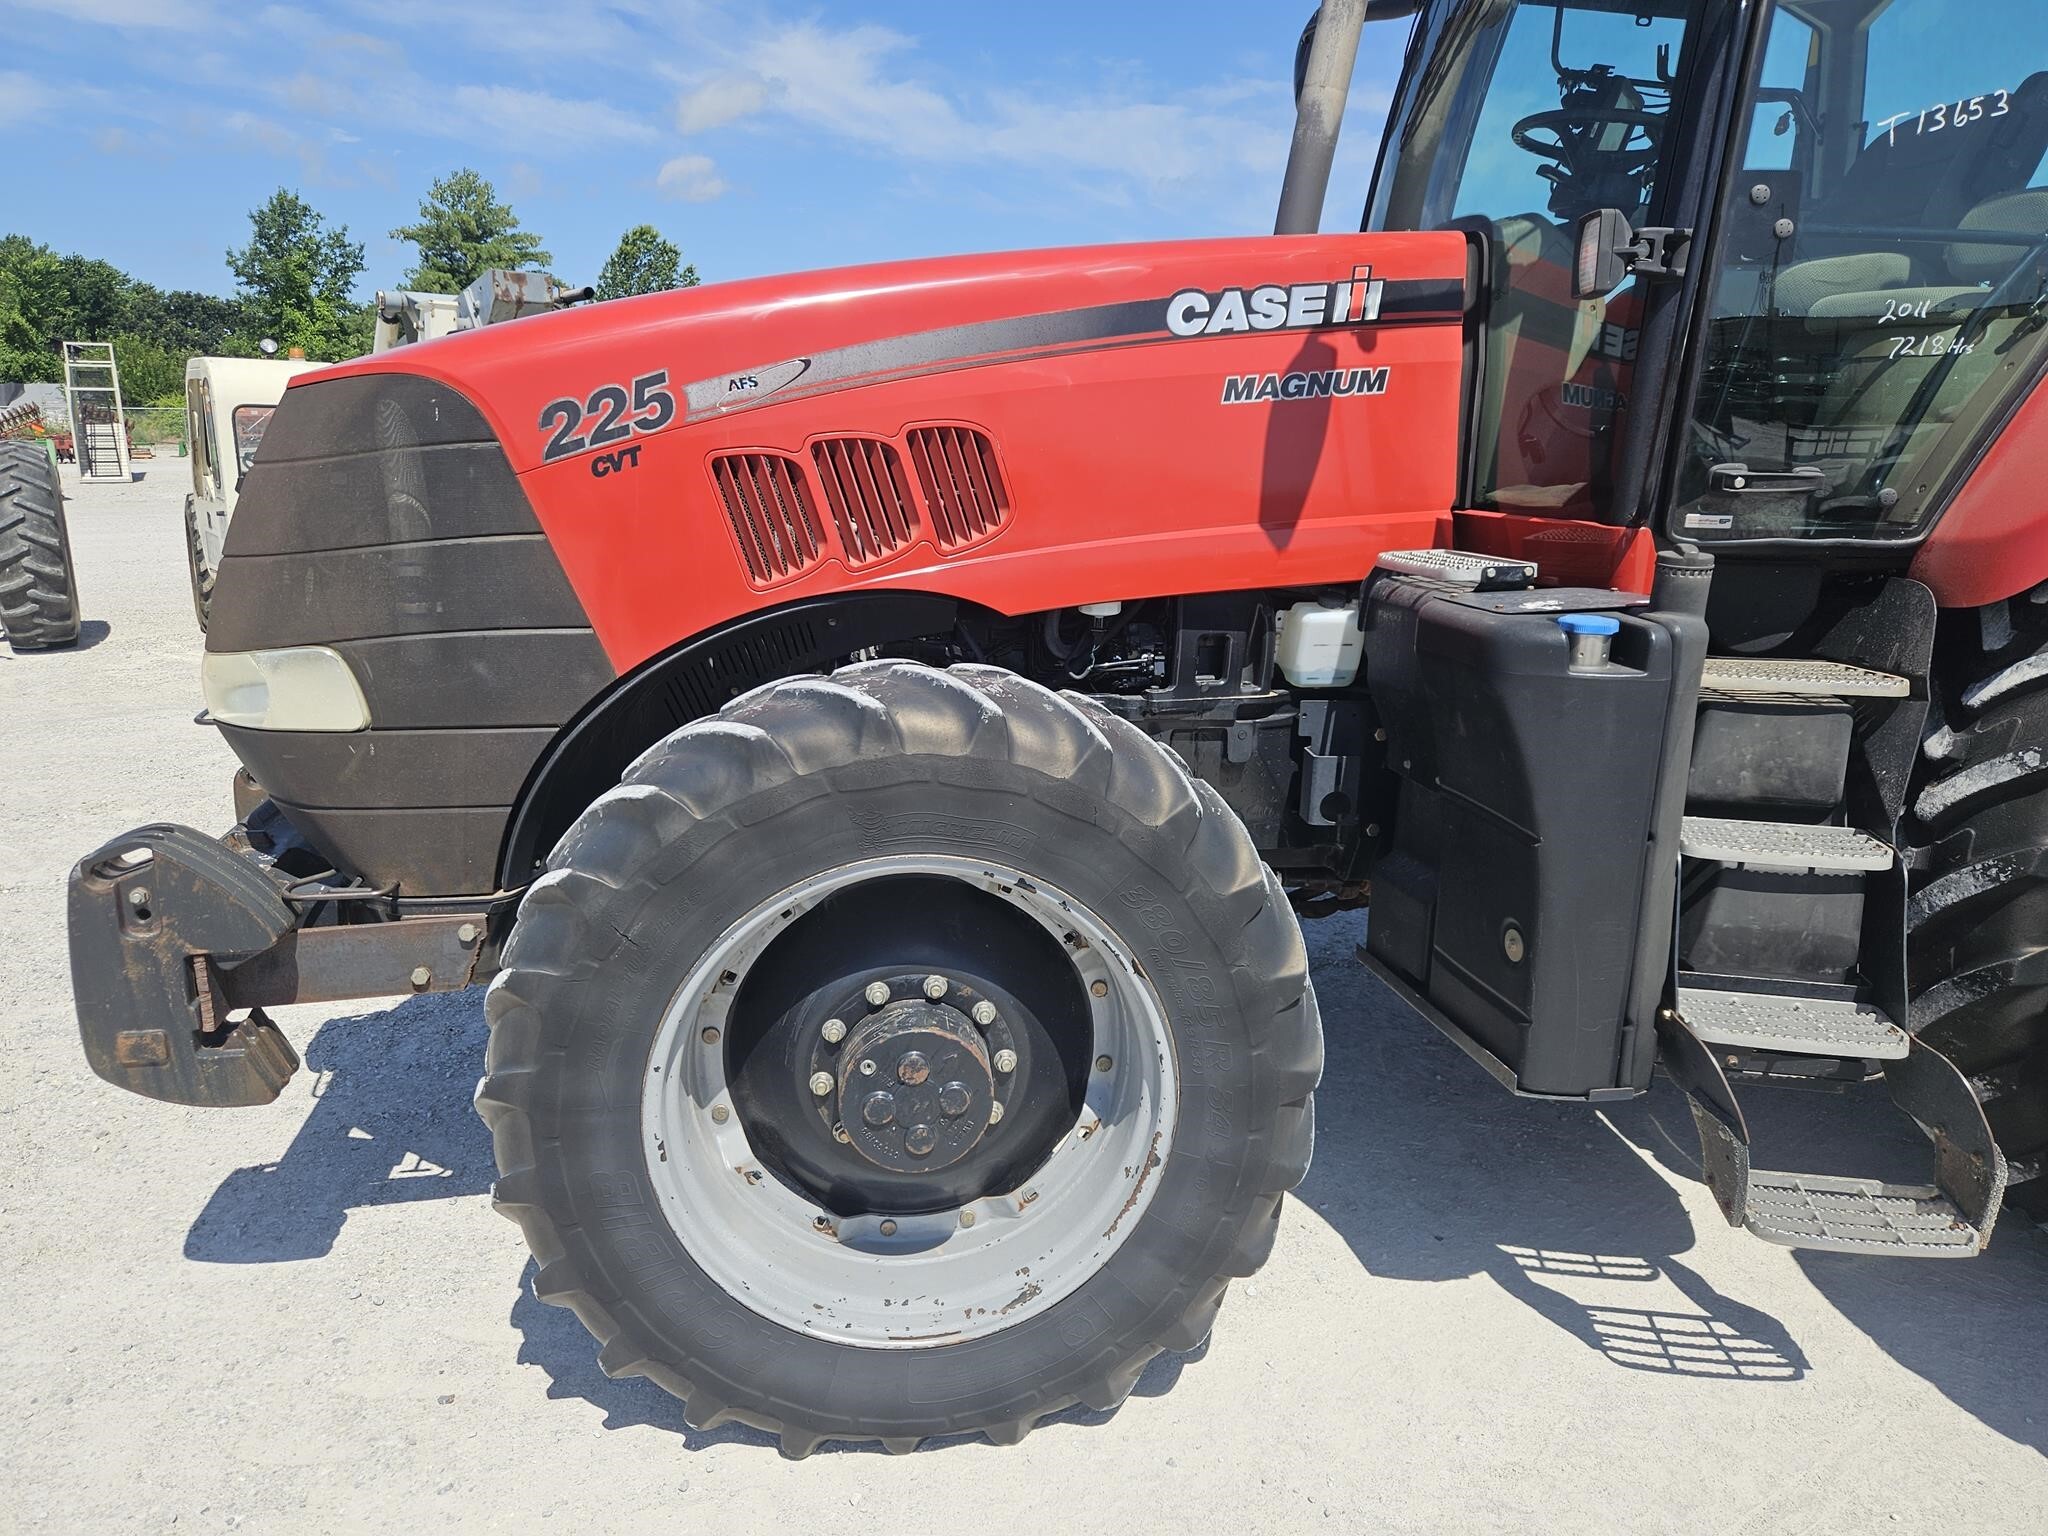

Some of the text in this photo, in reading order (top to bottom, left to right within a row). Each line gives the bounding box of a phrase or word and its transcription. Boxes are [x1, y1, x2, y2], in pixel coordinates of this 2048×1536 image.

[1166, 282, 1329, 338] CASE
[1878, 298, 1931, 324] 2011
[727, 375, 760, 392] AFS
[1221, 366, 1391, 405] MAGNUM
[538, 367, 677, 464] 225
[591, 444, 642, 478] CVT
[891, 818, 1029, 852] MICHELIN
